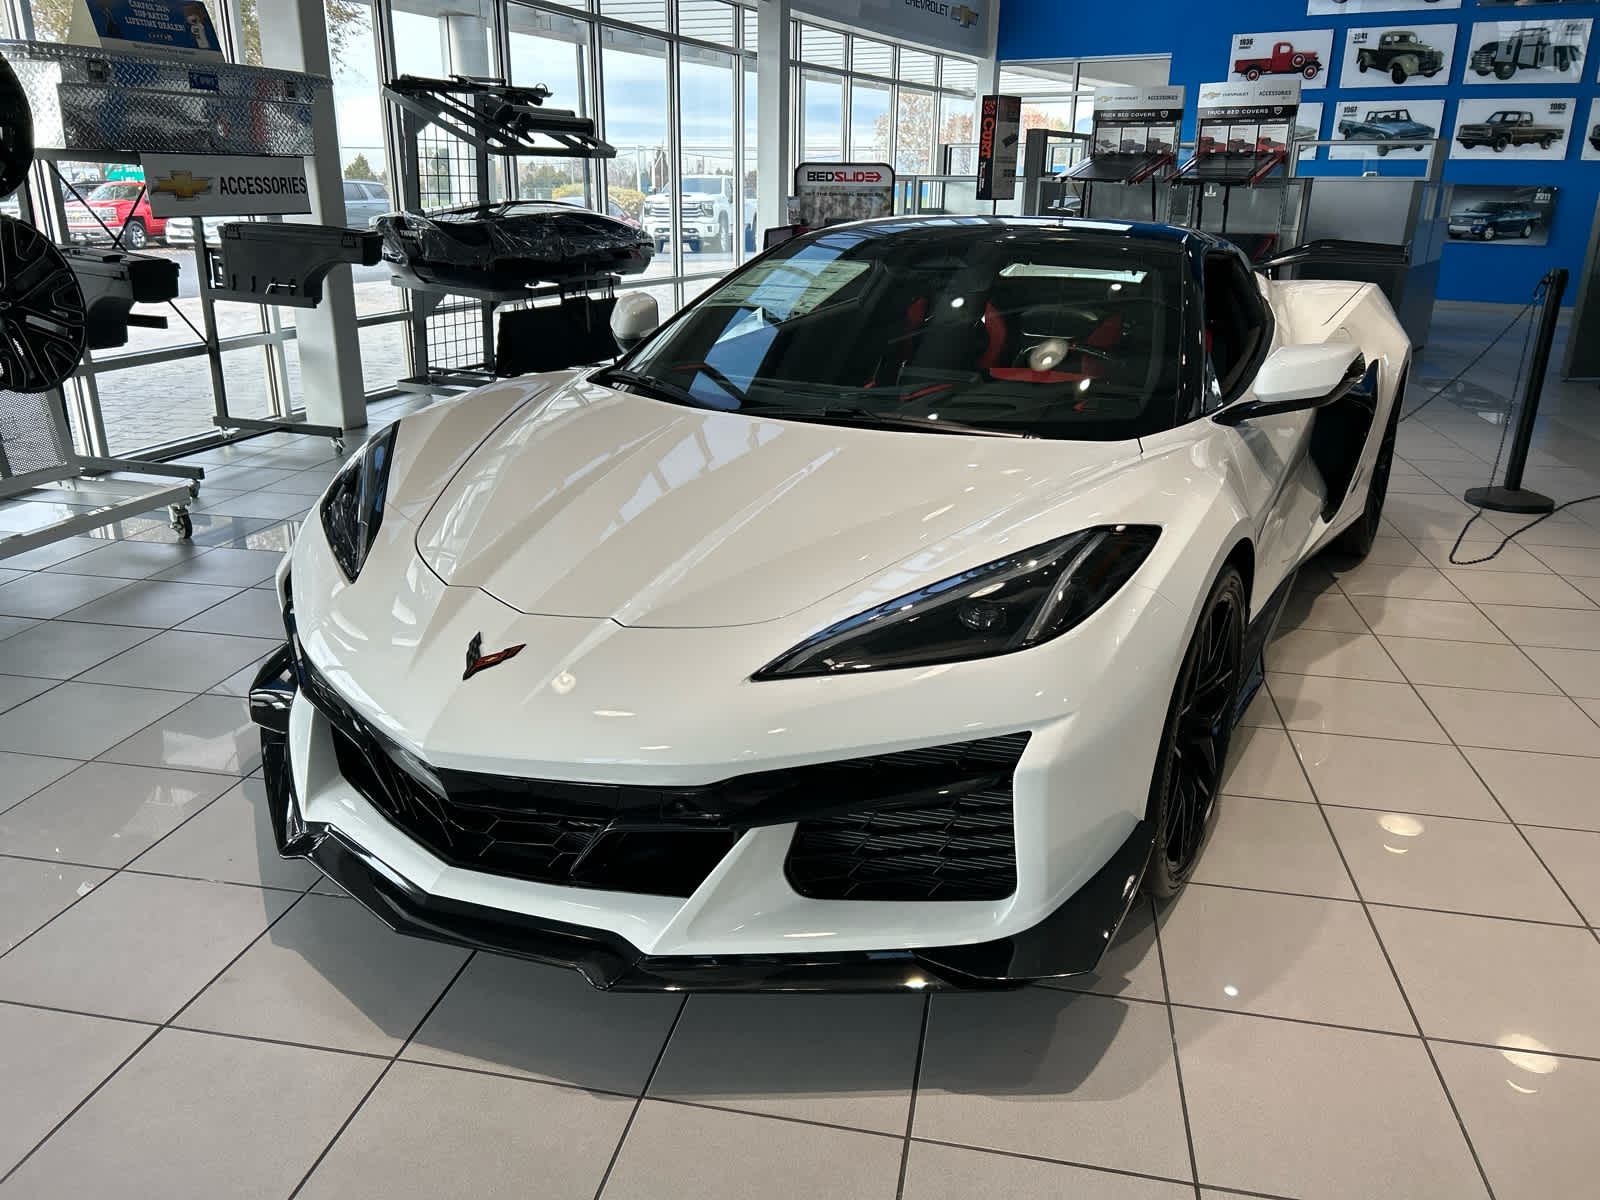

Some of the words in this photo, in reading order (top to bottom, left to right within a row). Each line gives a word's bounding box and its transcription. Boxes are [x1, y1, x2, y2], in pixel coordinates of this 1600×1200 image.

[980, 117, 995, 159] CURT
[219, 176, 307, 195] ACCESSORIES
[807, 171, 882, 182] BEDSLIDE
